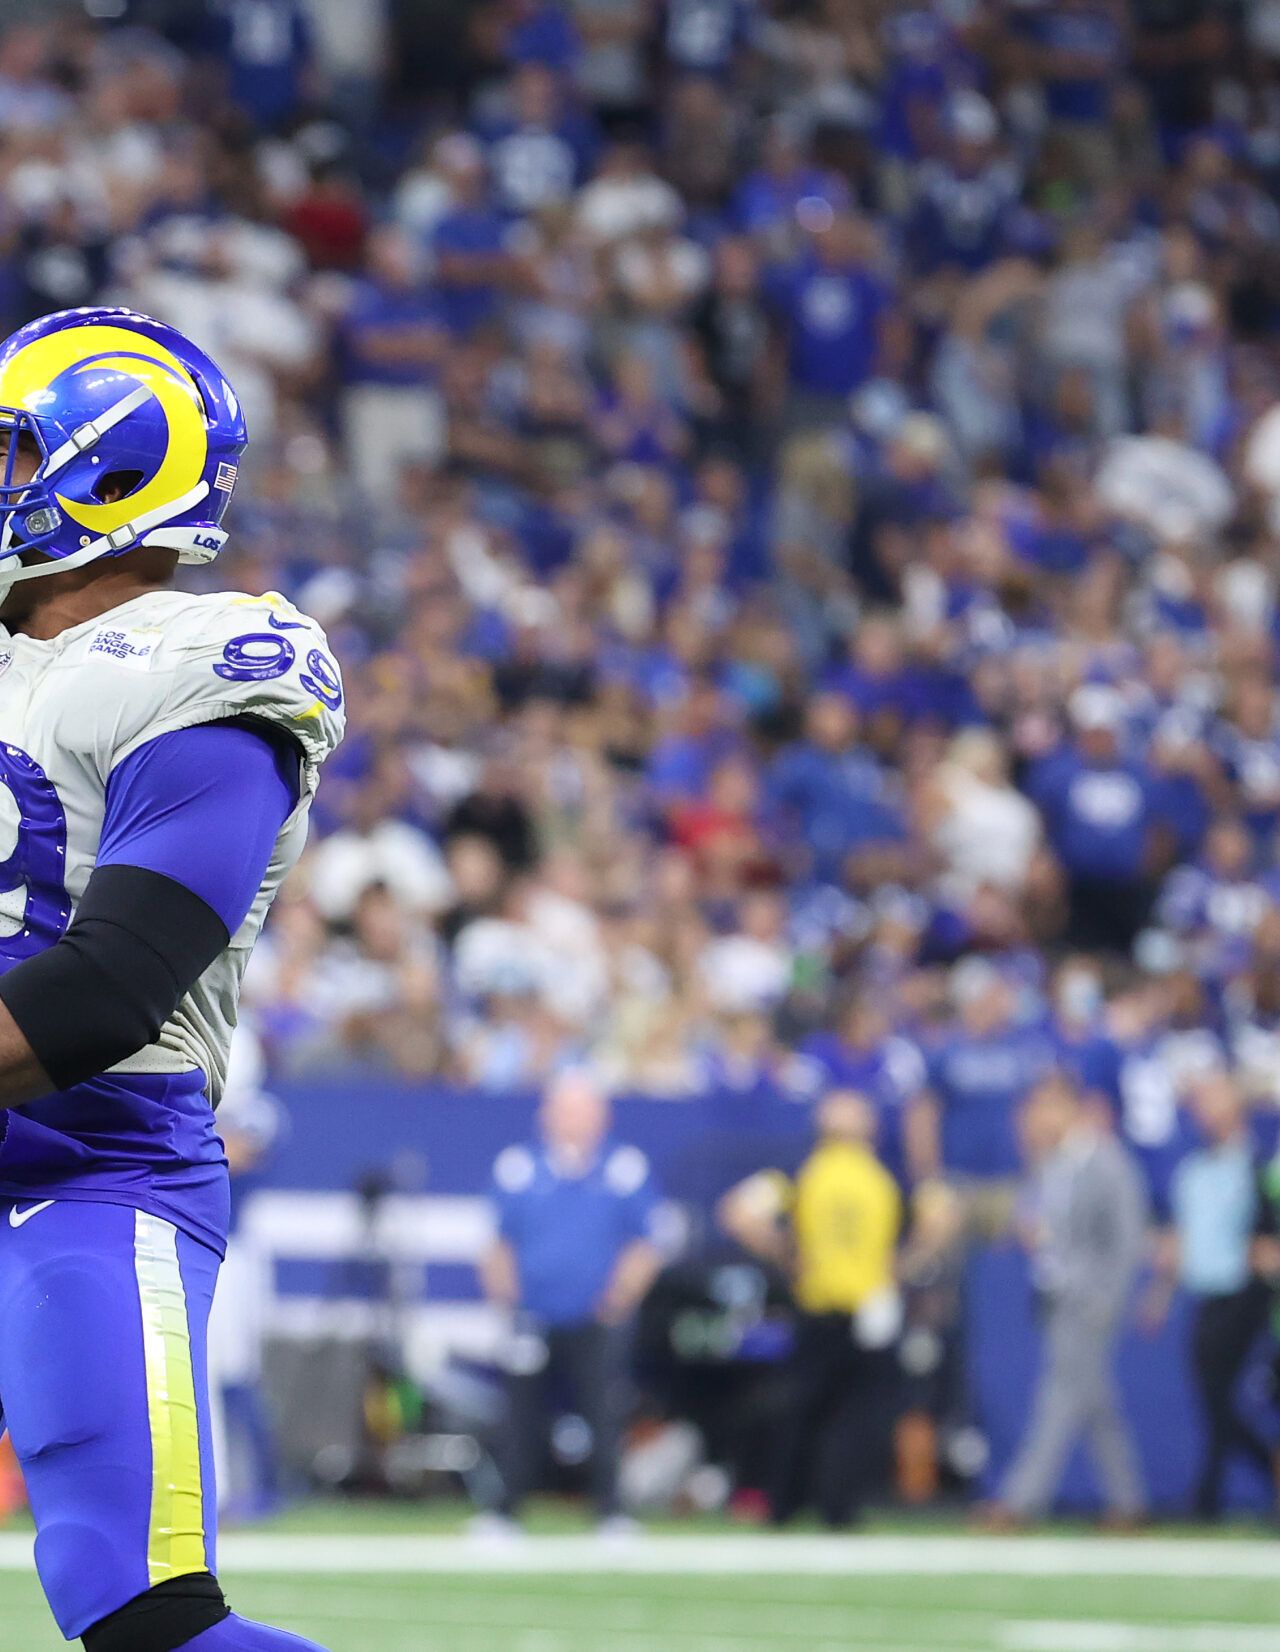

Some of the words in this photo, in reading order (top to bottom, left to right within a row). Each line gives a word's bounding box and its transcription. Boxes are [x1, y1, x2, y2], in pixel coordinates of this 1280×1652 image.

[193, 534, 221, 550] LOS
[97, 631, 126, 640] LOS
[213, 633, 342, 711] 99
